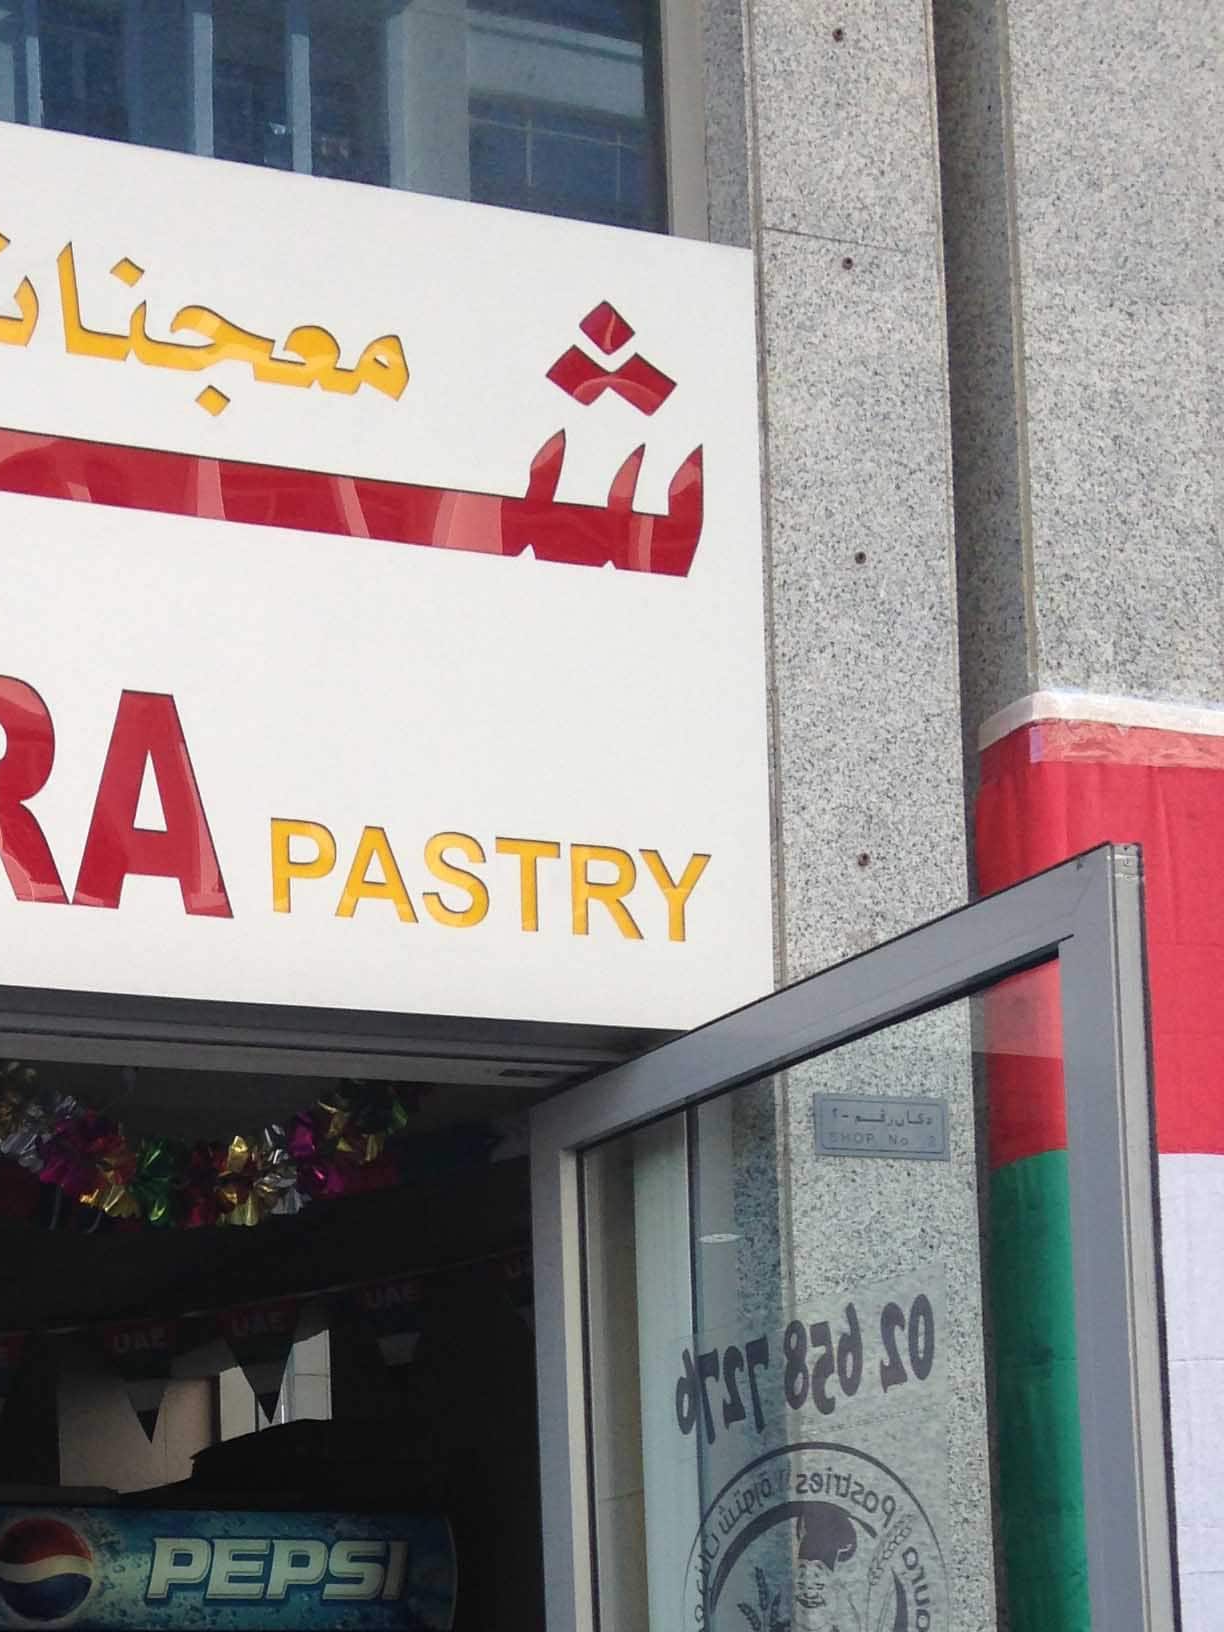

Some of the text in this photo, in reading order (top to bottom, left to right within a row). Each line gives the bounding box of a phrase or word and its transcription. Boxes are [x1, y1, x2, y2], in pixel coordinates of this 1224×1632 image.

[271, 817, 710, 943] PASTRY
[828, 1131, 875, 1145] SHOP
[112, 1326, 168, 1354] UAE
[144, 1537, 410, 1602] PEPSI
